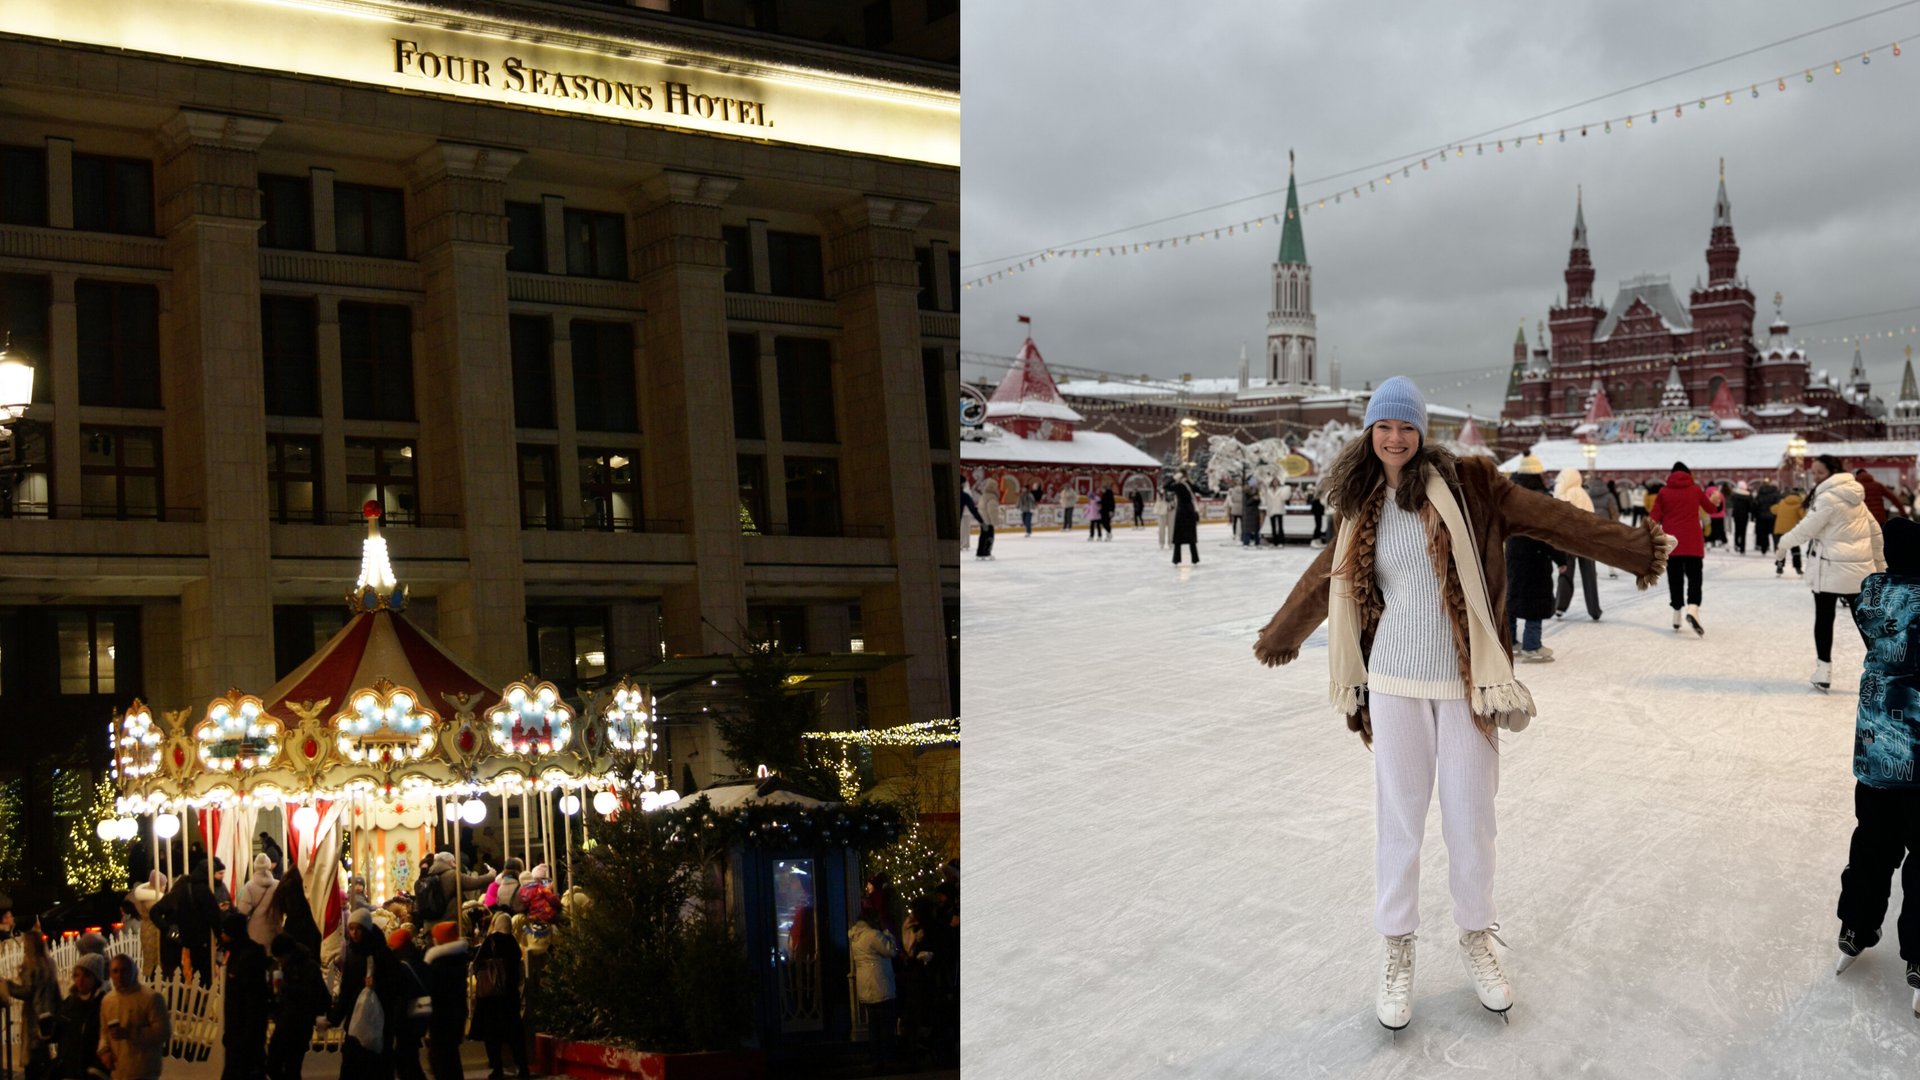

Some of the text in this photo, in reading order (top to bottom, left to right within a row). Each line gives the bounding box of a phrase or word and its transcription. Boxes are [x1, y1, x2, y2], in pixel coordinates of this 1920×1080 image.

[391, 37, 774, 128] FOUR SEASONS HOTEL
